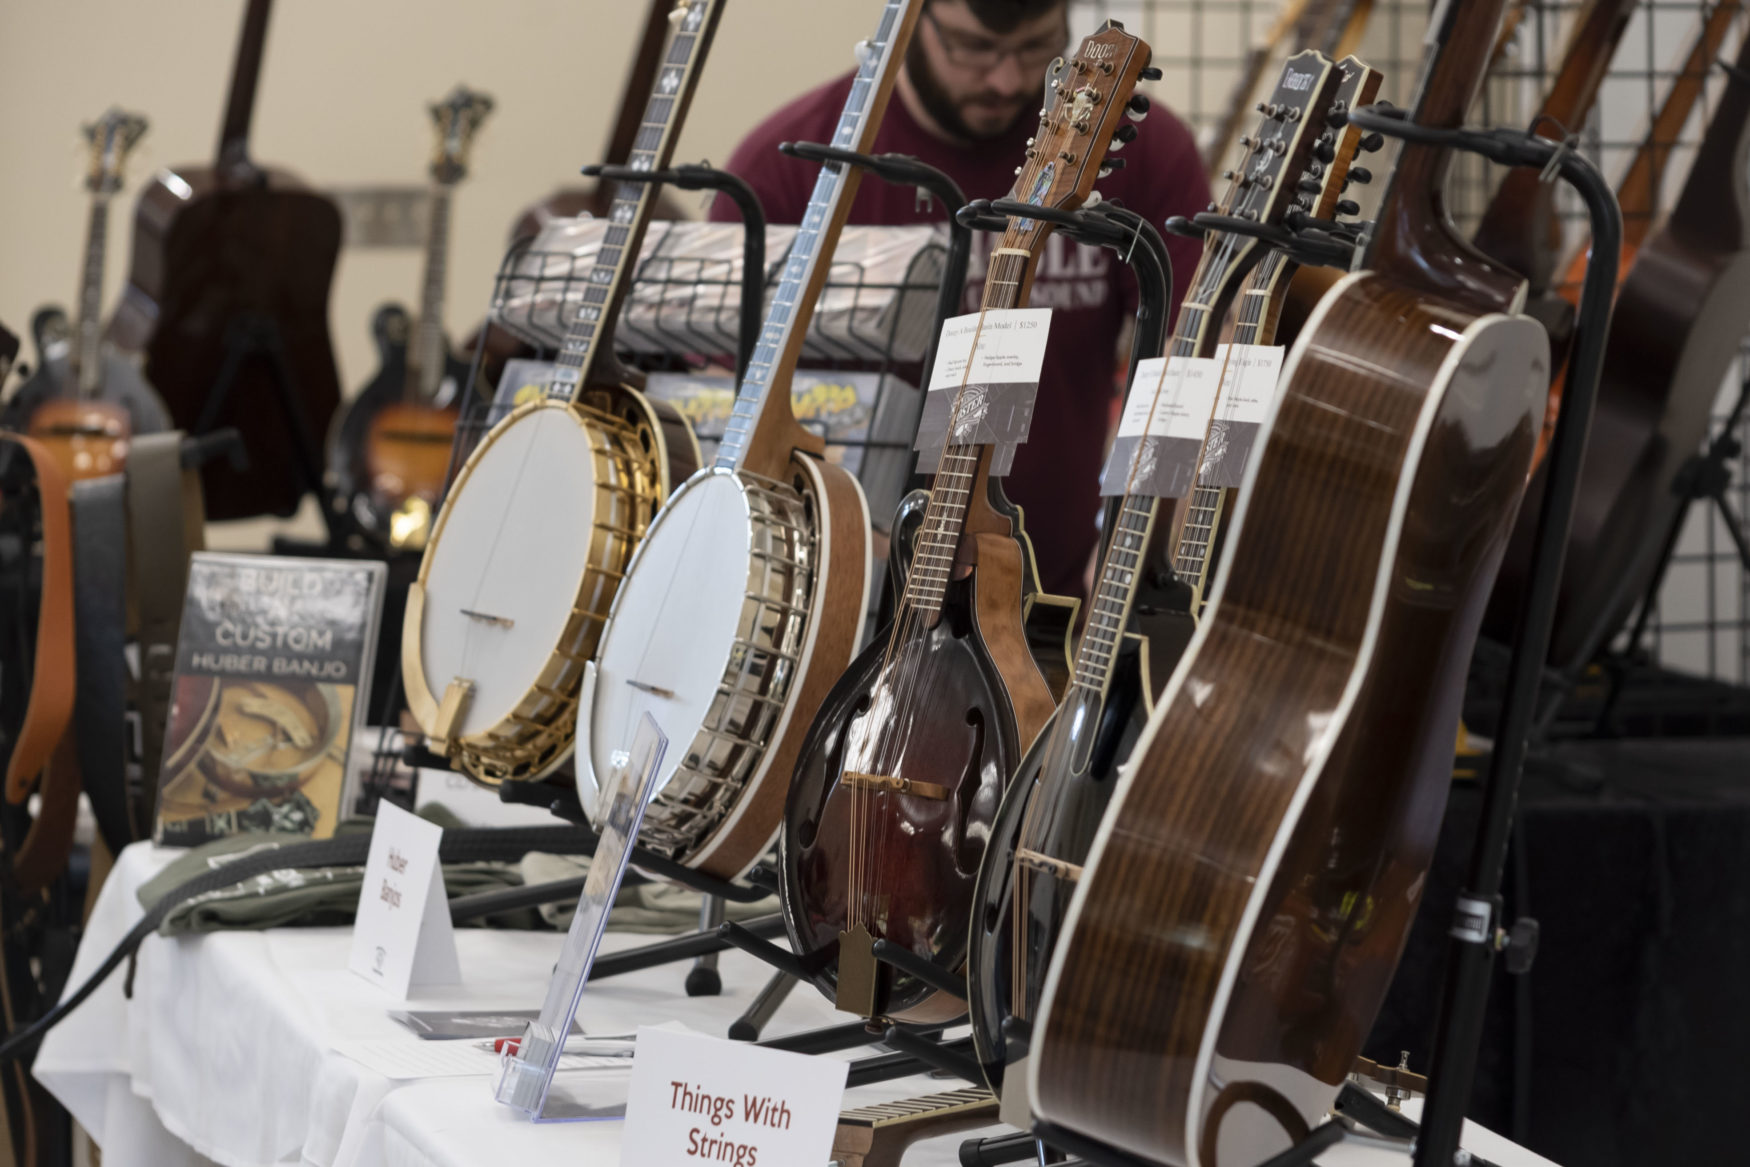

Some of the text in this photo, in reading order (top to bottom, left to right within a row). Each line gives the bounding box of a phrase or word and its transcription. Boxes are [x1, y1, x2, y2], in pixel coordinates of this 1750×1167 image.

[994, 320, 1012, 330] Model
[1019, 319, 1038, 329] $1250
[238, 568, 323, 596] BUILD
[214, 620, 334, 652] CUSTOM
[191, 652, 348, 679] HUBER BANJO
[671, 1080, 792, 1130] Things With
[687, 1127, 758, 1167] Strings
